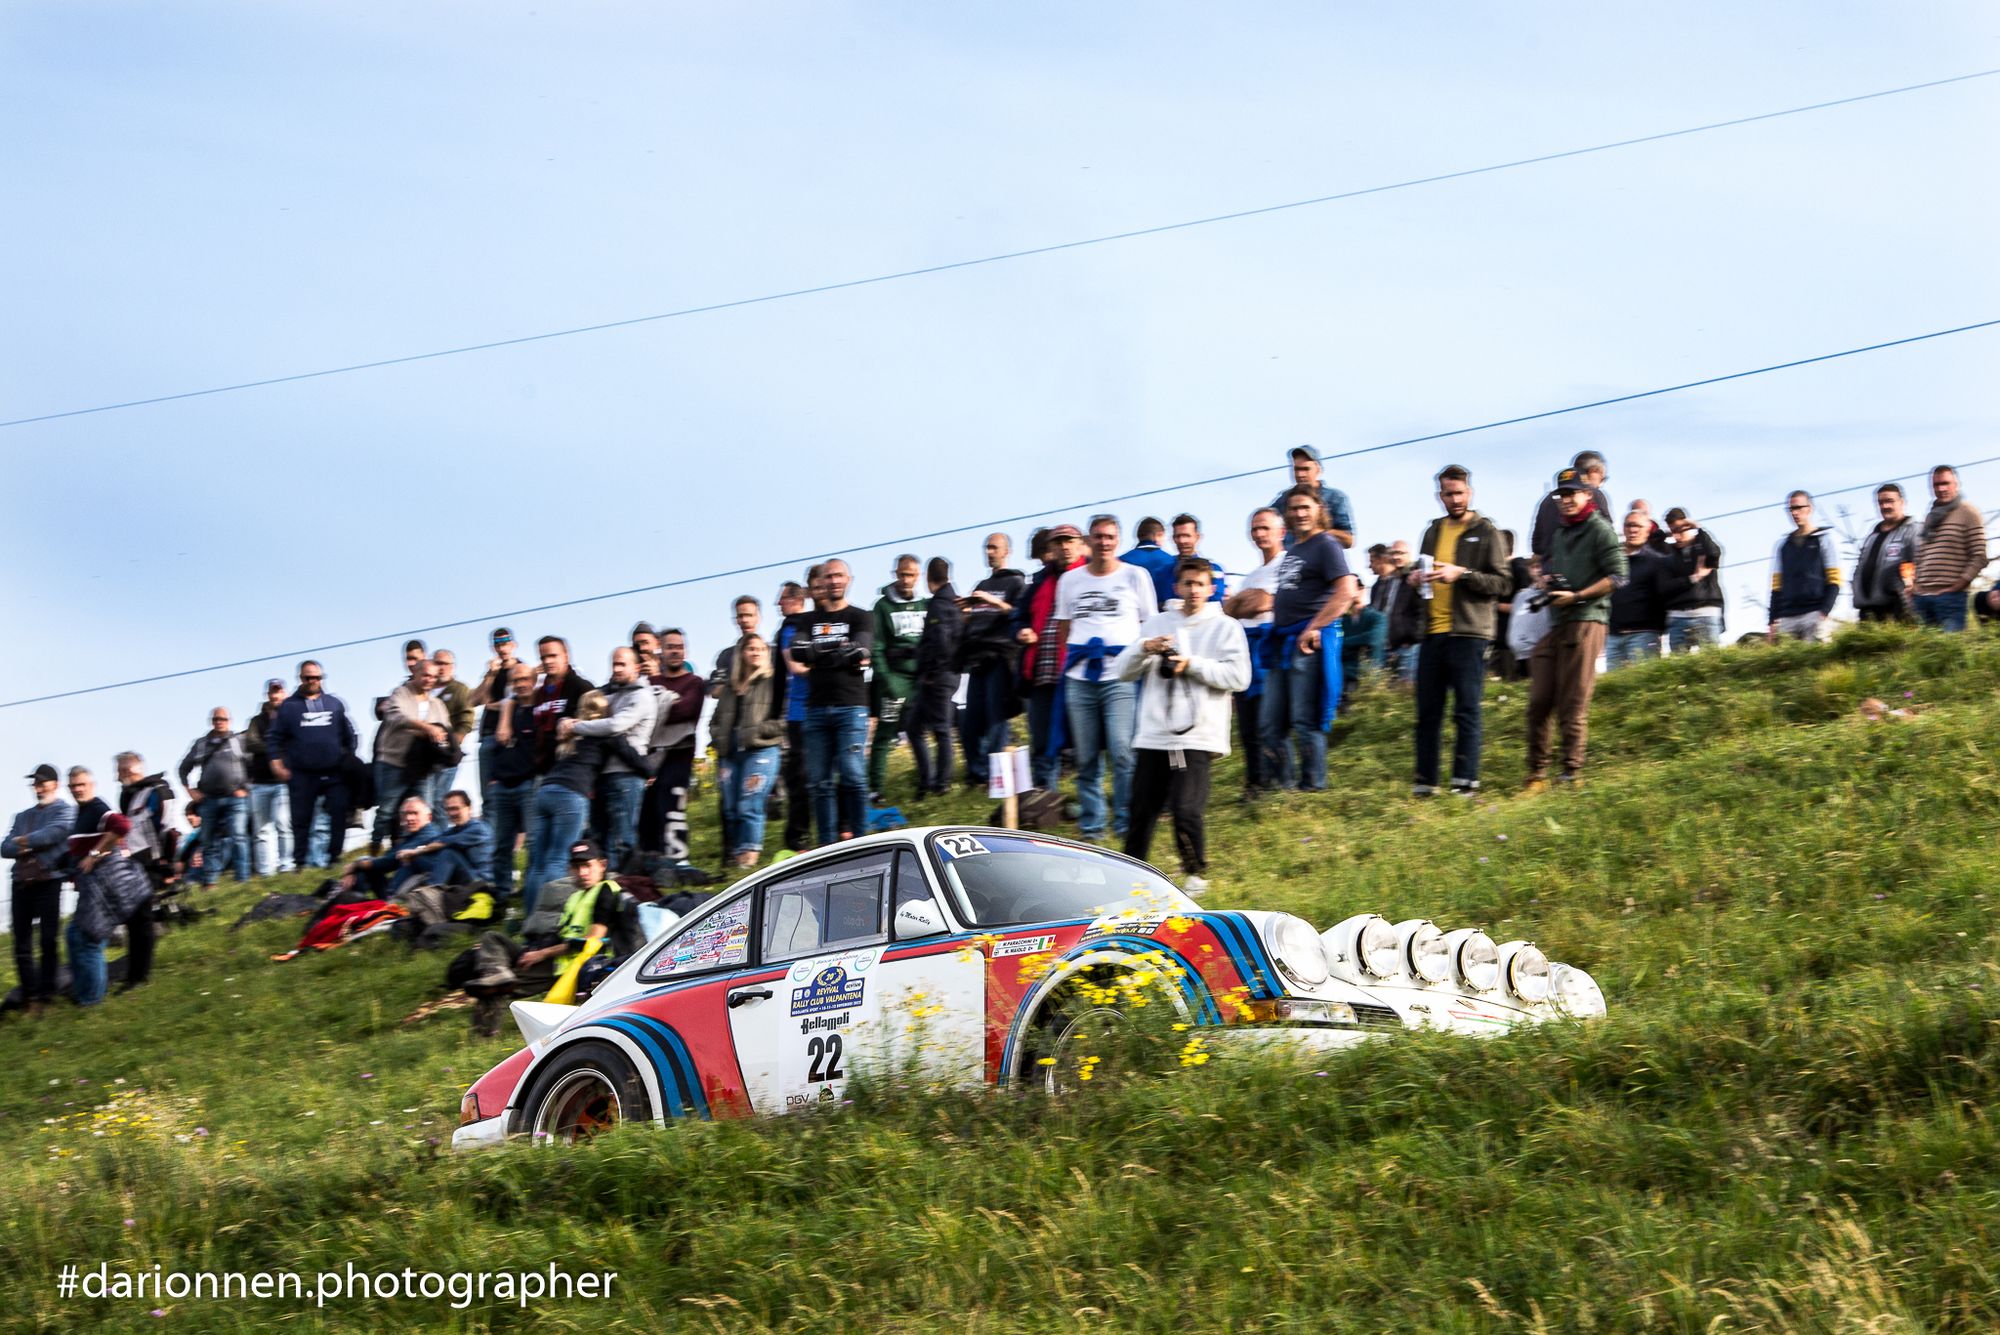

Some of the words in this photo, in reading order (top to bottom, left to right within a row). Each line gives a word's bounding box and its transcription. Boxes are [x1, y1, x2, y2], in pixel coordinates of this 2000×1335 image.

[943, 837, 986, 855] 22
[905, 911, 918, 920] Motor
[816, 986, 839, 996] REVIVAL
[792, 1000, 810, 1010] RALLY
[810, 997, 824, 1006] CLUB
[826, 991, 862, 1003] VALPANTENA
[808, 1034, 844, 1084] 22
[786, 1094, 810, 1106] DGV
